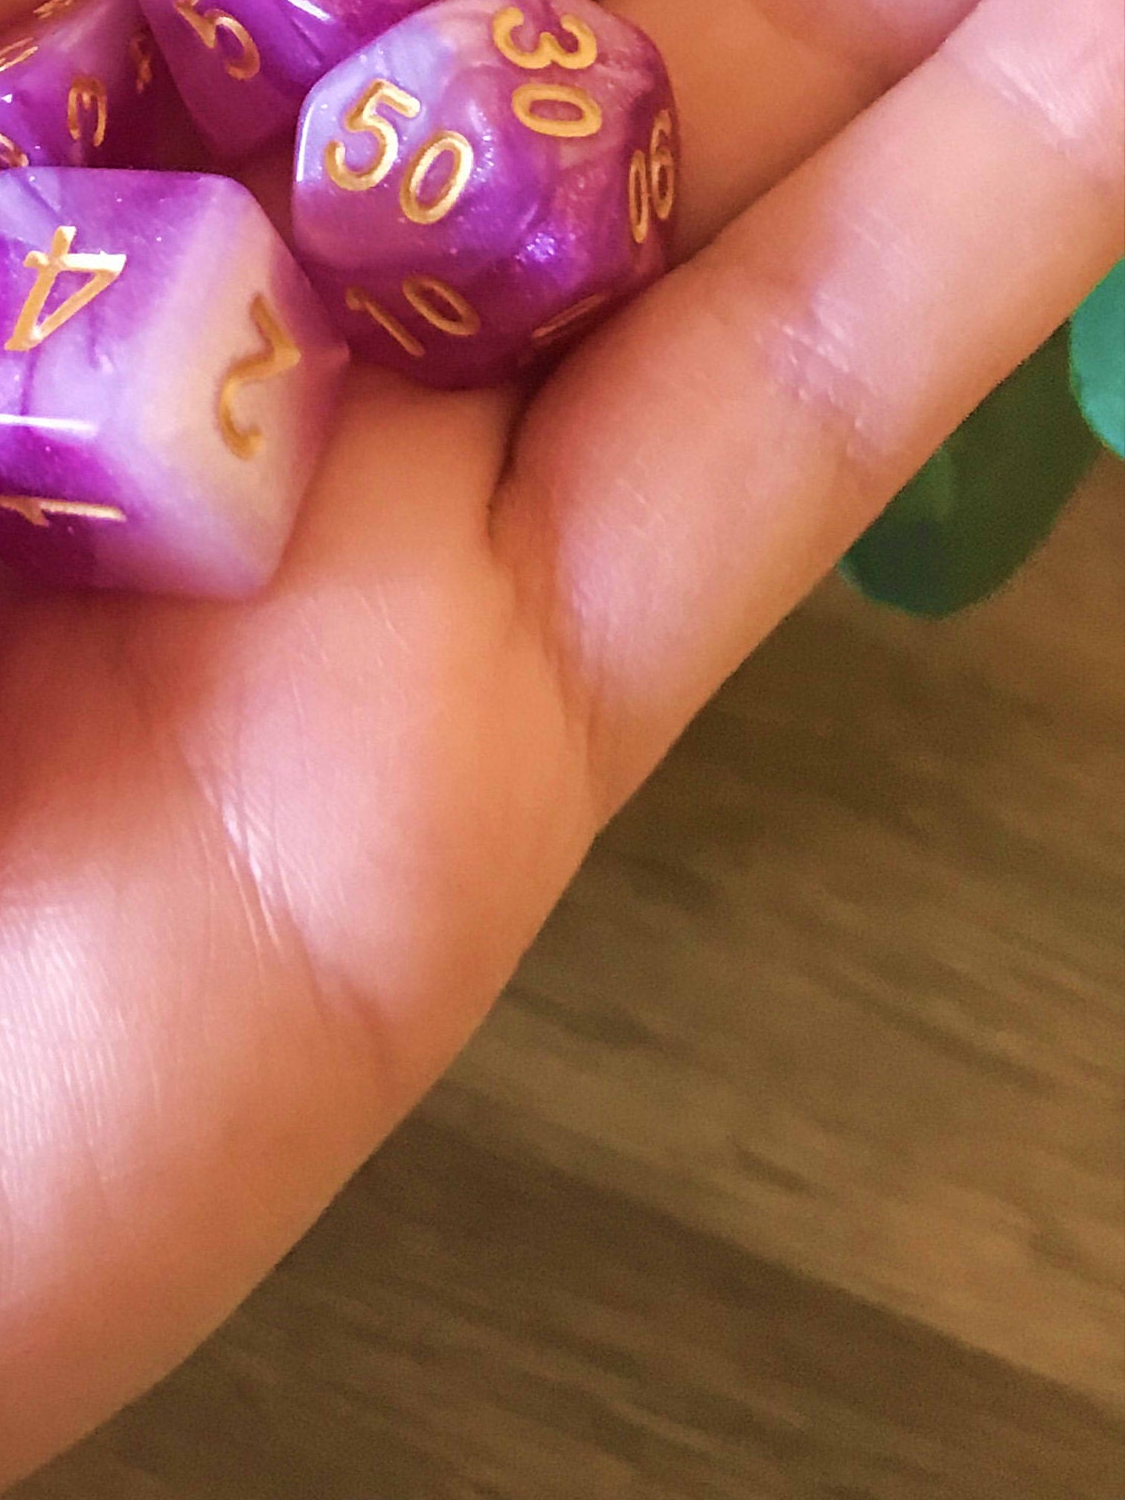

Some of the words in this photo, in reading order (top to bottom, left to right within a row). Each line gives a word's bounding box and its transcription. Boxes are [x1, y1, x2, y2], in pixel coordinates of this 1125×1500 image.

[493, 7, 603, 138] 30
[324, 78, 474, 225] 50
[4, 225, 127, 351] 4
[345, 274, 481, 357] 10
[218, 291, 302, 461] 2
